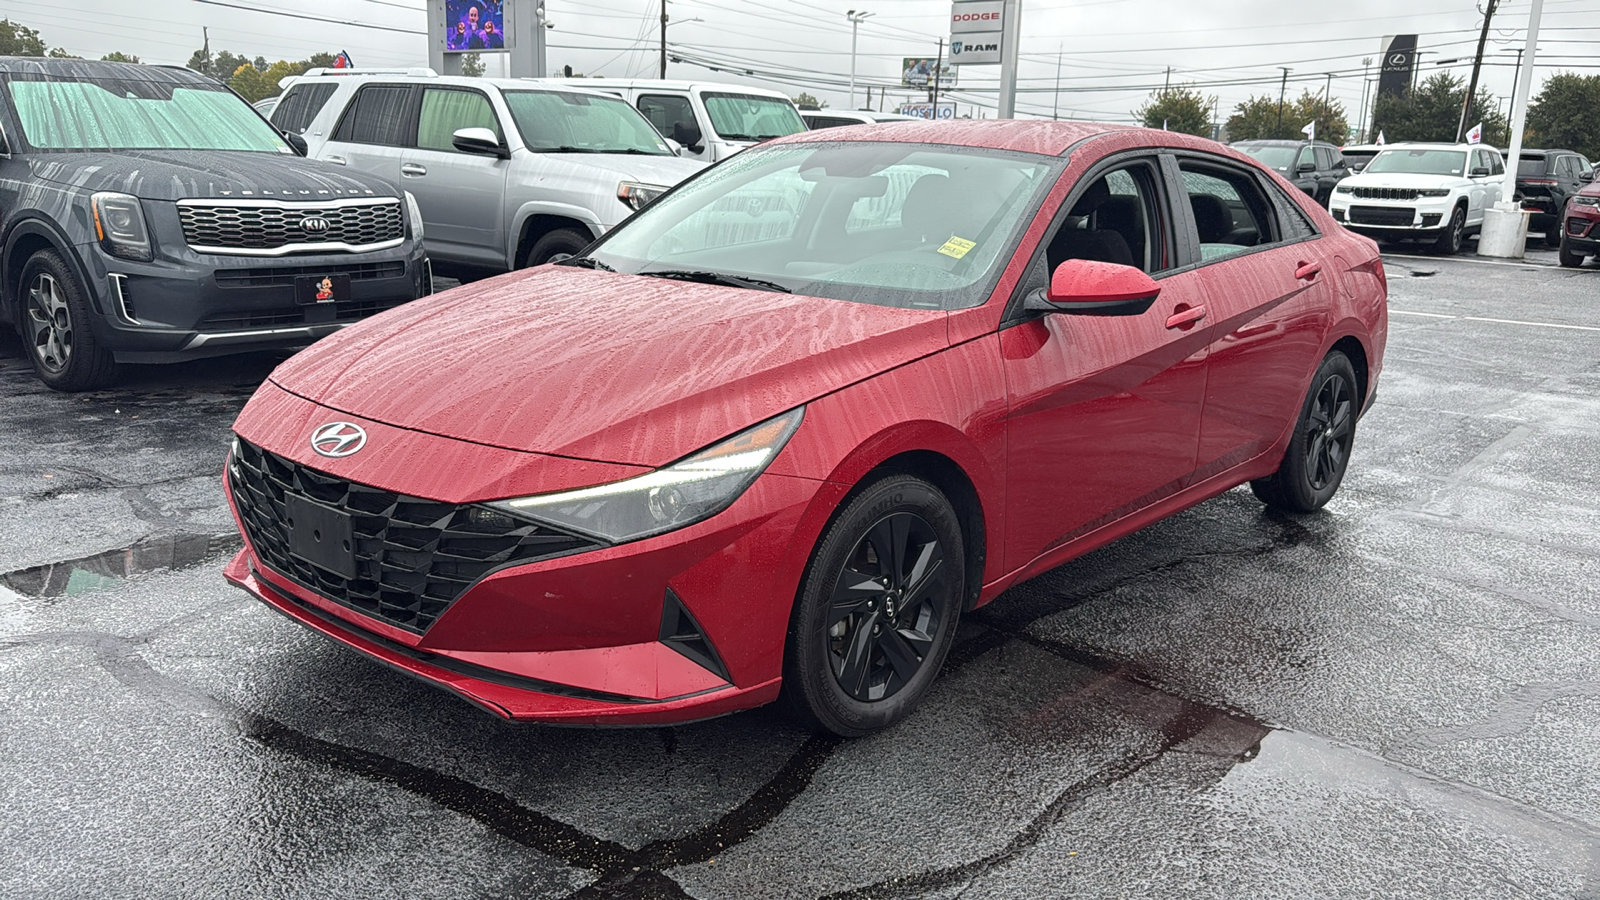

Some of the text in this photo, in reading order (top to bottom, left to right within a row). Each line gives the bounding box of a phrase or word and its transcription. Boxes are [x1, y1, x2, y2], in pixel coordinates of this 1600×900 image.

[953, 12, 1000, 22] DODGE
[964, 44, 998, 52] RAM
[902, 108, 952, 119] HOSTLO
[305, 219, 327, 231] KIA
